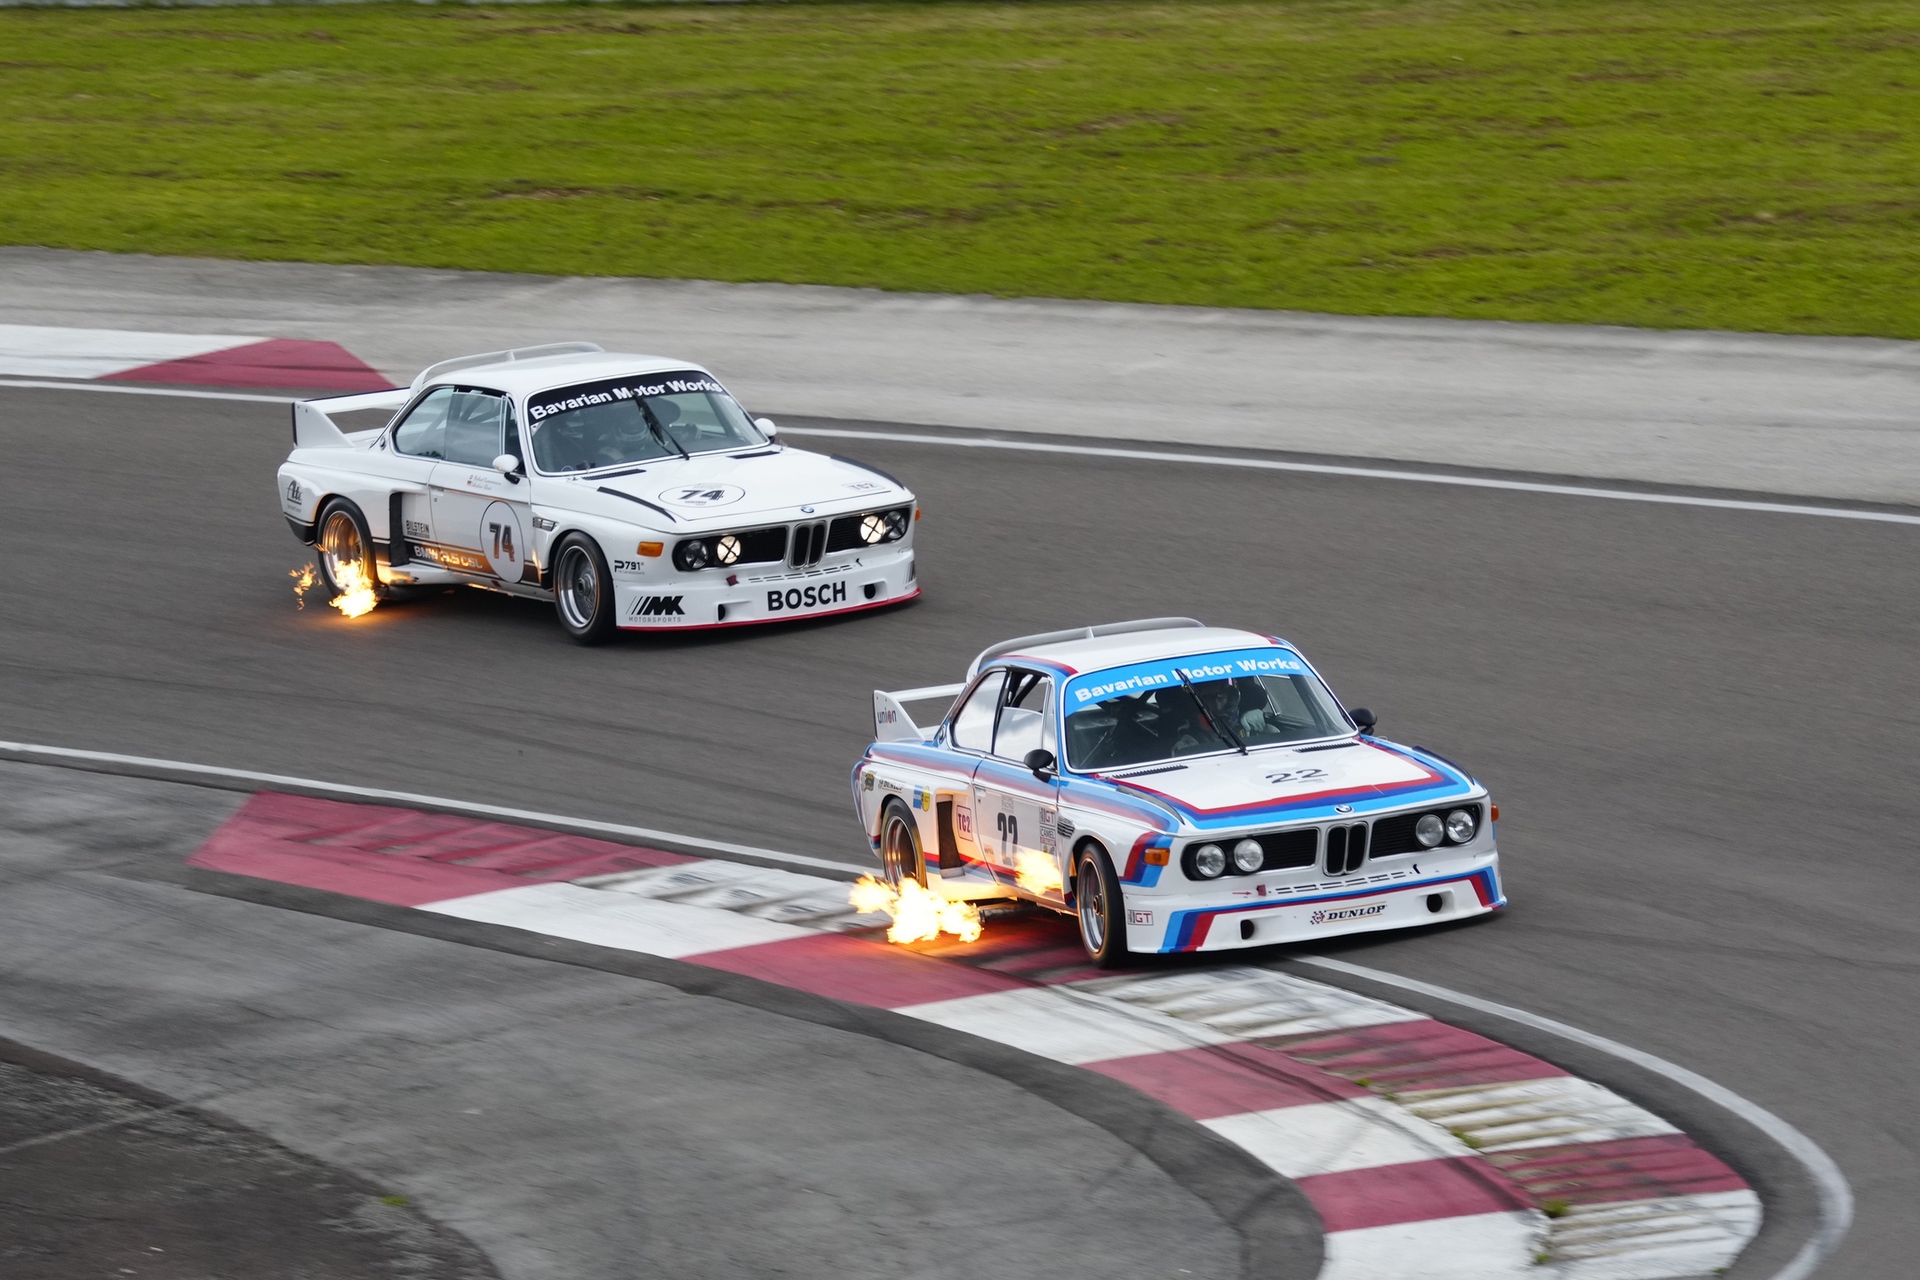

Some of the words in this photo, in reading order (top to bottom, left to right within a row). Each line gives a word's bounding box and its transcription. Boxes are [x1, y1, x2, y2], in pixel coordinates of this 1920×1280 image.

[530, 391, 613, 420] Bavarian
[666, 379, 722, 393] Works
[677, 489, 725, 501] 74
[406, 520, 429, 534] BILSTEIN
[489, 522, 515, 562] 74
[414, 545, 438, 560] BMW
[461, 556, 483, 569] CSL
[768, 581, 847, 611] BOSCH
[1074, 674, 1169, 702] Bavarian
[1173, 664, 1233, 683] Motor
[1236, 657, 1300, 672] Works
[877, 707, 897, 724] union
[1265, 768, 1329, 784] 22
[957, 813, 971, 834] TC2
[997, 812, 1018, 866] 22
[1136, 912, 1152, 923] GT
[1328, 905, 1385, 921] DUNLOP
